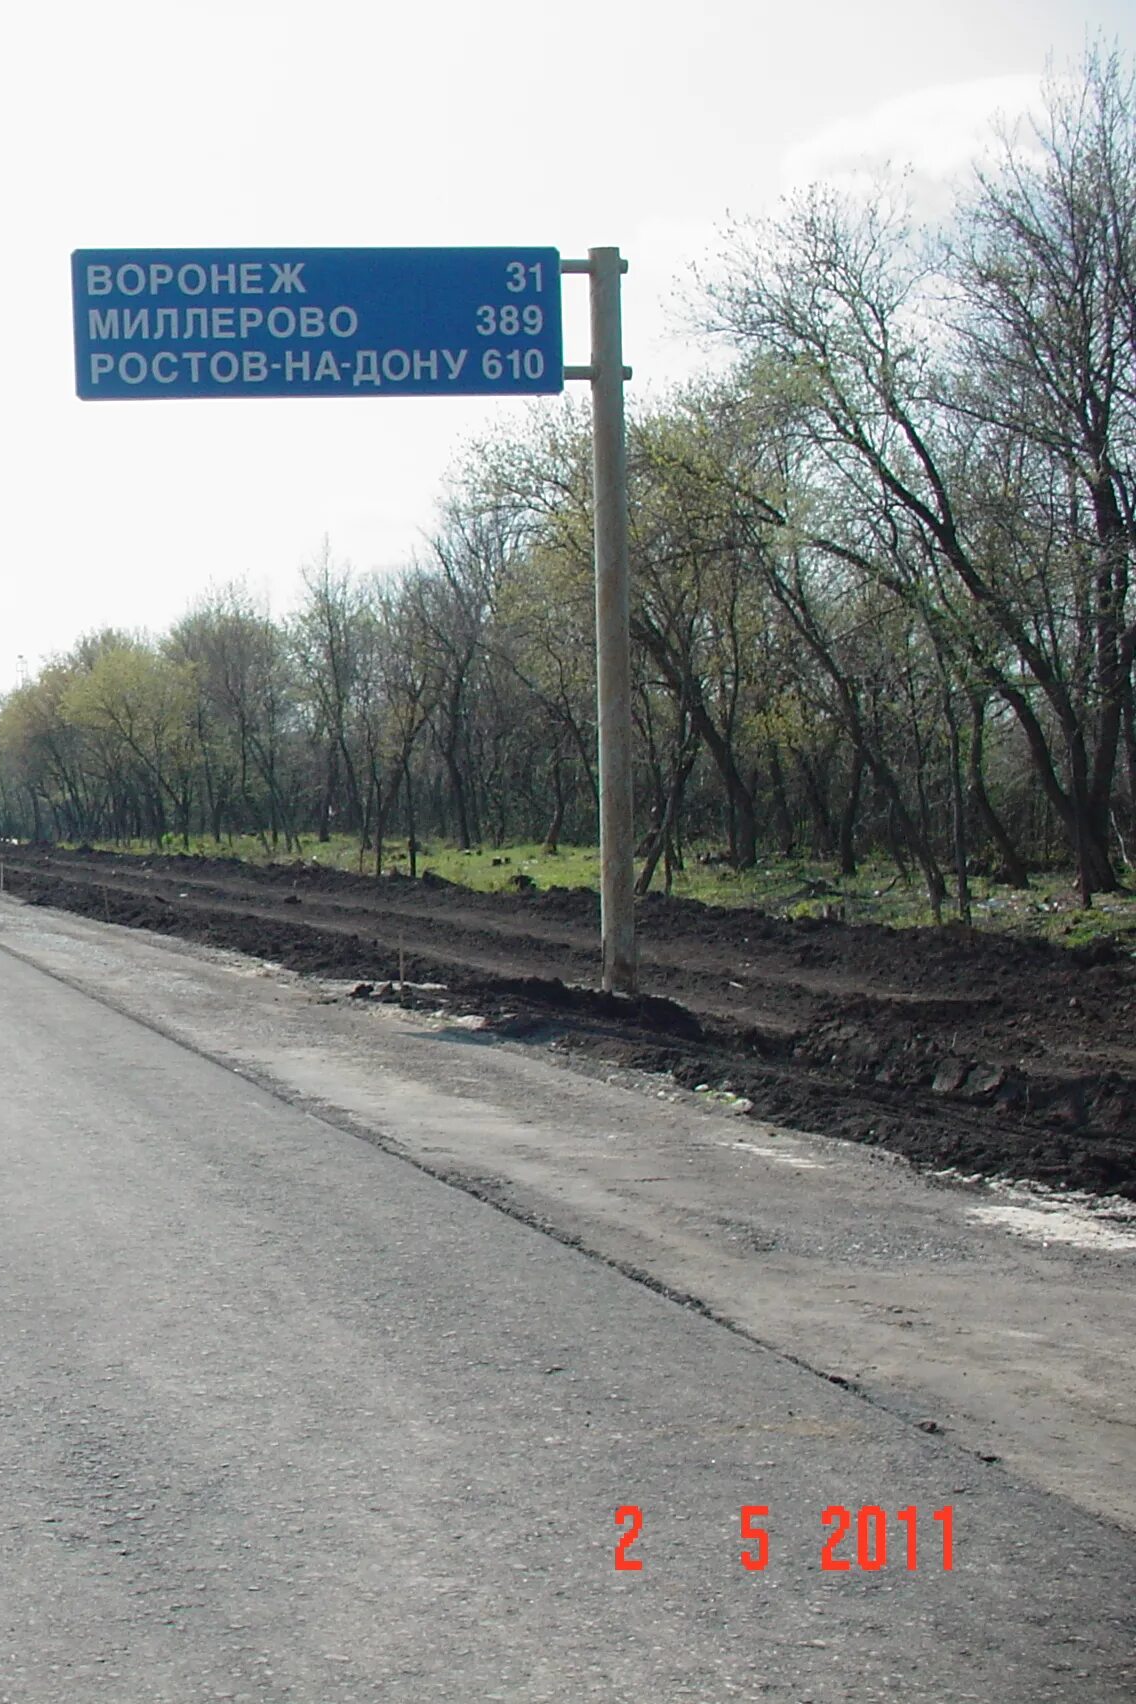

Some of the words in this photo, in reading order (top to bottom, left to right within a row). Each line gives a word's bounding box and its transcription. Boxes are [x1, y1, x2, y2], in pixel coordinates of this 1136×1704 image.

[87, 262, 306, 295] ВОРОНЕЖ
[506, 262, 544, 293] 31
[89, 306, 359, 340] МИЛЛЕРОВО
[476, 305, 544, 335] 389
[91, 349, 468, 386] РОСТОВ-НА-ДОНУ
[482, 348, 544, 380] 610
